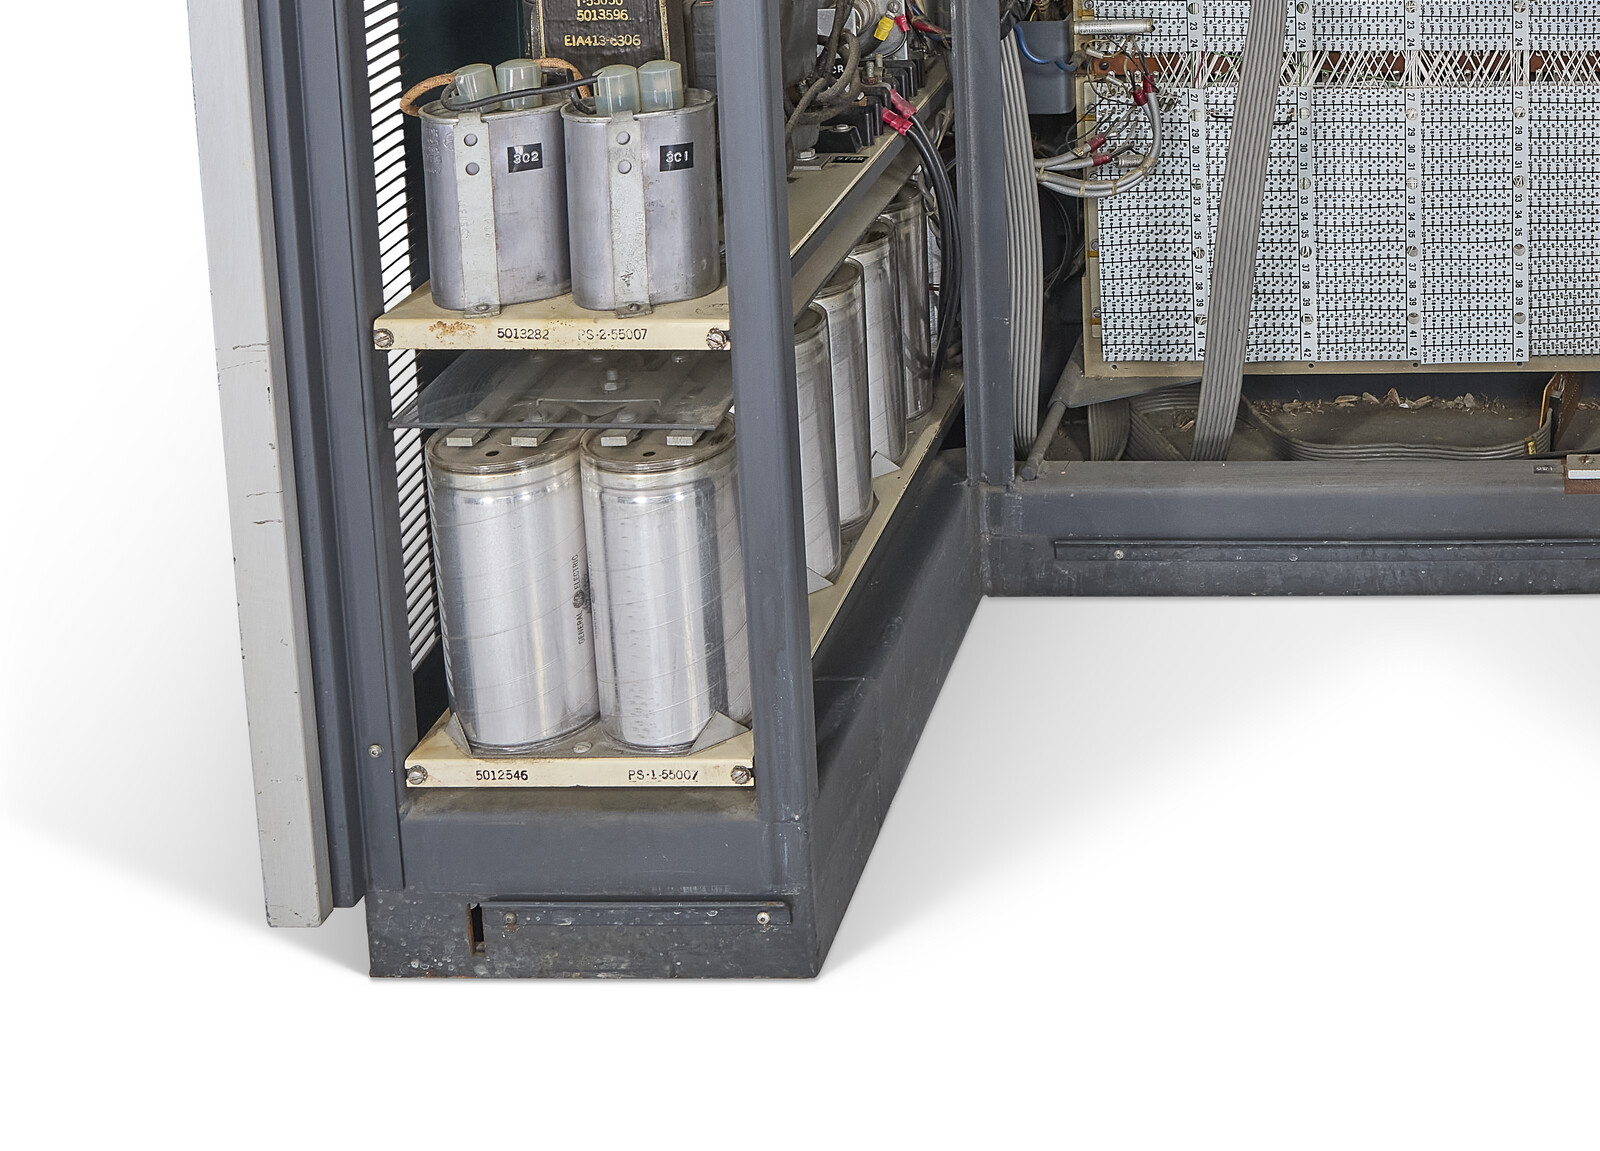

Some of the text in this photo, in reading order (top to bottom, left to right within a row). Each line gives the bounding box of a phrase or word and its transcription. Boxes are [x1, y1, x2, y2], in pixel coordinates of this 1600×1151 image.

[576, 8, 629, 22] 5013596
[1190, 22, 1198, 31] 23
[1298, 22, 1306, 31] 23
[1407, 21, 1415, 29] 23
[1515, 20, 1523, 29] 23
[1190, 39, 1198, 48] 24
[1298, 39, 1306, 48] 24
[1407, 38, 1415, 47] 24
[1515, 38, 1523, 46] 24
[1190, 94, 1198, 102] 27
[1299, 92, 1307, 100] 27
[1407, 93, 1415, 101] 27
[1515, 91, 1523, 99] 27
[1192, 128, 1199, 137] 29
[1300, 127, 1308, 136] 29
[1408, 128, 1416, 136] 29
[1515, 126, 1523, 135] 29
[1192, 145, 1200, 154] 30
[1300, 143, 1308, 152] 30
[1408, 144, 1416, 153] 30
[1515, 142, 1523, 151] 30
[1192, 163, 1200, 171] 31
[1300, 162, 1308, 170] 31
[1407, 162, 1416, 170] 31
[1193, 196, 1201, 205] 33
[1300, 196, 1308, 204] 33
[1408, 196, 1416, 204] 33
[1515, 194, 1522, 202] 33
[1193, 213, 1201, 222] 34
[1301, 212, 1309, 221] 34
[1408, 212, 1415, 221] 34
[1515, 210, 1522, 219] 34
[1194, 231, 1202, 239] 35
[1301, 229, 1309, 238] 35
[1408, 229, 1416, 238] 35
[1515, 227, 1522, 236] 35
[1195, 265, 1203, 273] 37
[1302, 264, 1310, 272] 37
[1408, 263, 1417, 271] 37
[1515, 262, 1523, 271] 37
[1195, 282, 1203, 290] 38
[1302, 281, 1310, 289] 38
[1408, 280, 1417, 289] 38
[1515, 280, 1523, 288] 38
[1196, 299, 1204, 307] 39
[1302, 298, 1311, 306] 39
[1409, 297, 1417, 306] 39
[1515, 297, 1523, 305] 39
[497, 327, 550, 340] 5013282
[1197, 331, 1205, 339] 41
[1410, 330, 1417, 338] 41
[1516, 330, 1523, 338] 41
[1304, 348, 1312, 357] 42
[1410, 347, 1418, 356] 42
[1516, 348, 1524, 358] 42
[571, 553, 585, 645] GENERAL ELECTRIC
[475, 769, 529, 781] 5012546
